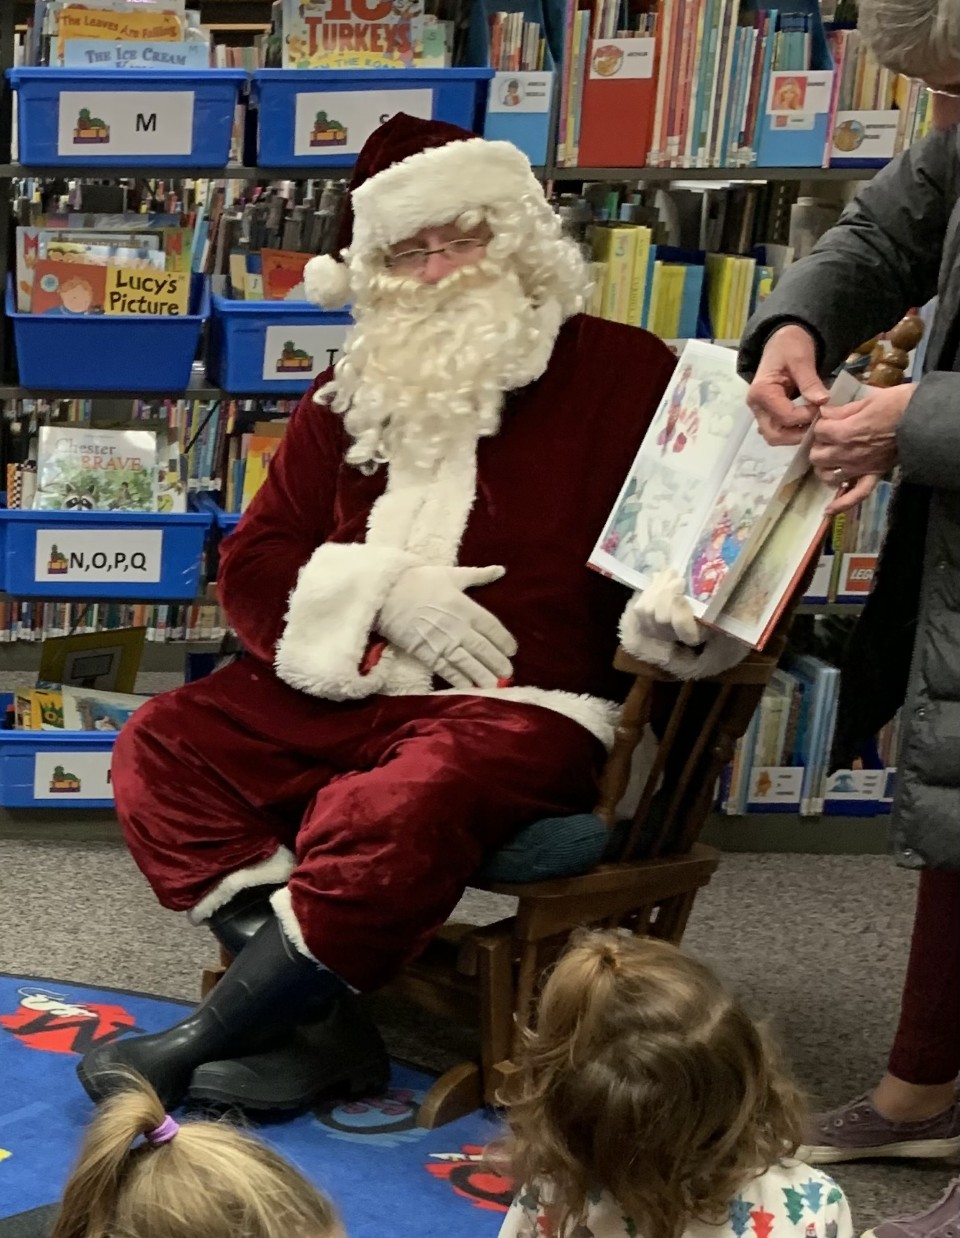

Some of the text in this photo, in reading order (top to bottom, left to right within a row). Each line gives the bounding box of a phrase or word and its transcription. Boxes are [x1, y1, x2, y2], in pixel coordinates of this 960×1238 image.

[63, 15, 178, 39] The Leaves Are Falling
[305, 16, 410, 56] TURKEYS
[135, 112, 157, 132] M
[116, 269, 178, 295] Lucy's
[109, 291, 180, 315] Picture
[56, 437, 117, 455] Chester
[69, 552, 148, 573] N,O,P,Q
